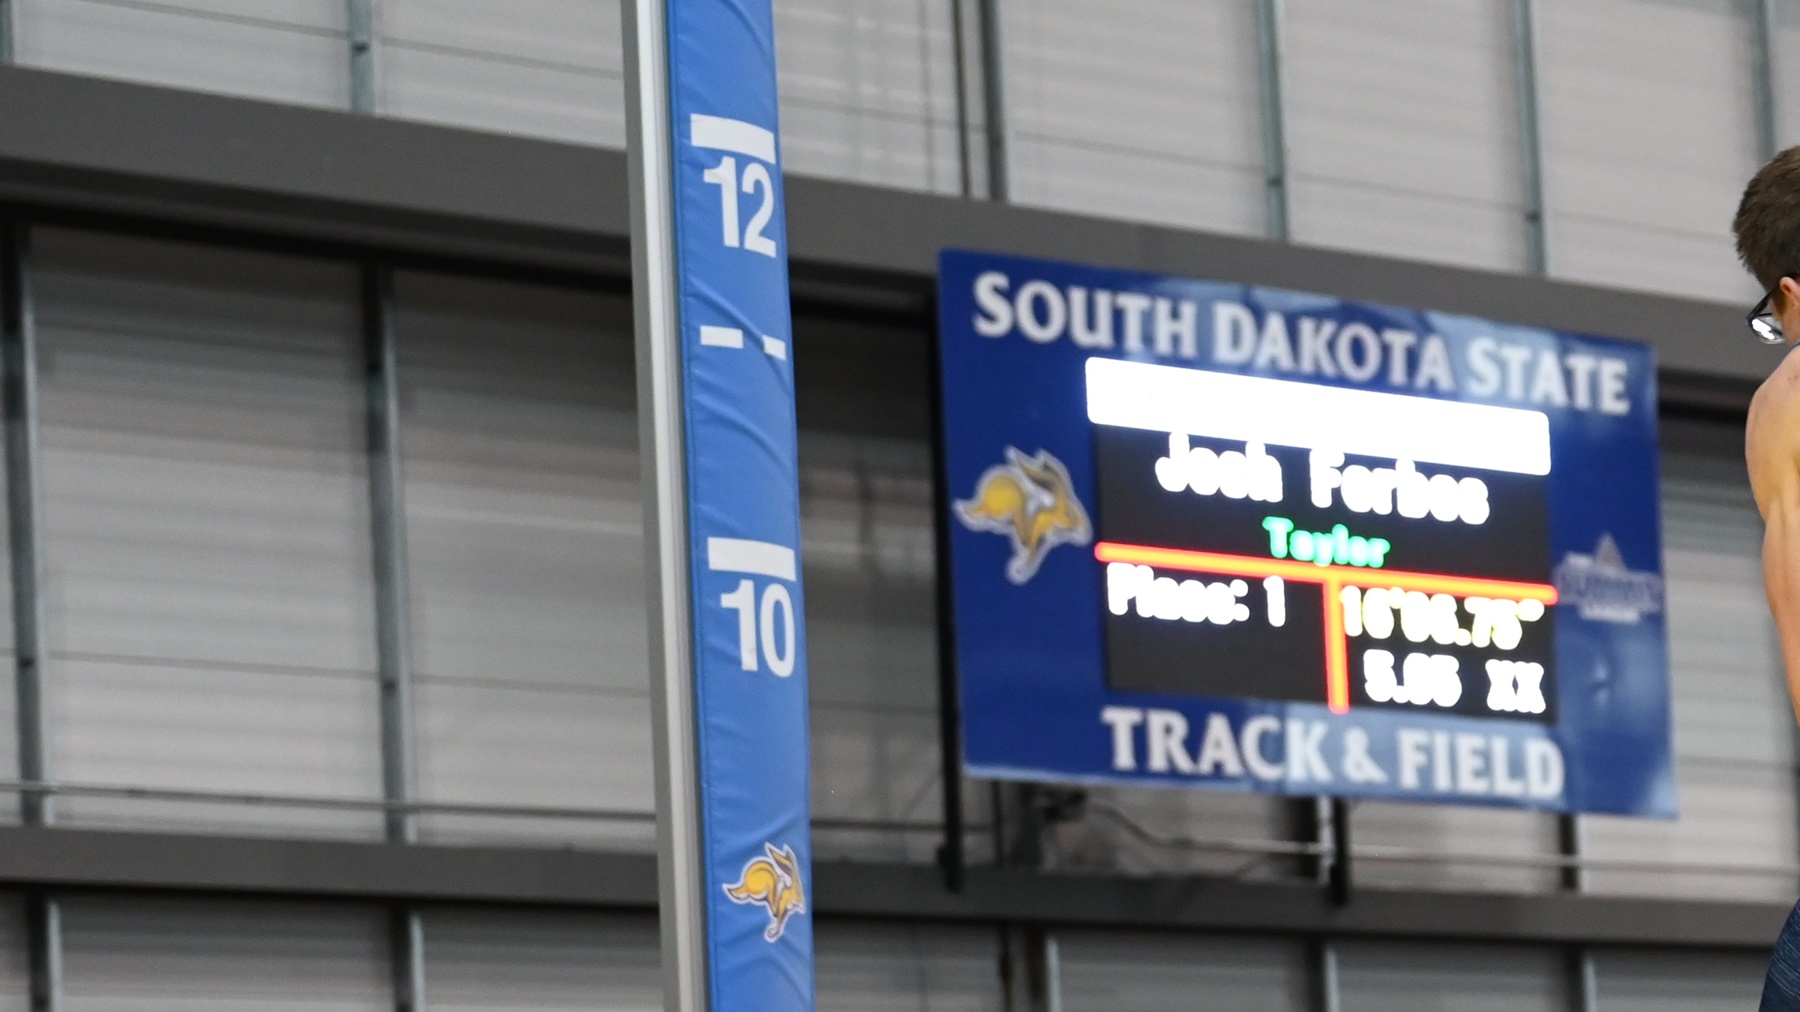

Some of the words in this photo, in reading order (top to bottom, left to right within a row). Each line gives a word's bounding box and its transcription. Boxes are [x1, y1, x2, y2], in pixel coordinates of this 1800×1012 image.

[702, 154, 778, 258] 12
[972, 271, 1198, 359] SOUTH
[1212, 301, 1455, 392] DAKOTA
[1466, 337, 1631, 415] STATE
[1155, 432, 1284, 502] Josh
[1310, 448, 1491, 525] Forbes
[1262, 516, 1391, 568] Taylor
[719, 577, 797, 679] 10
[1263, 575, 1287, 627] 1
[1102, 705, 1333, 784] TRACK
[1341, 726, 1389, 784] &
[1397, 728, 1566, 799] FIELD
